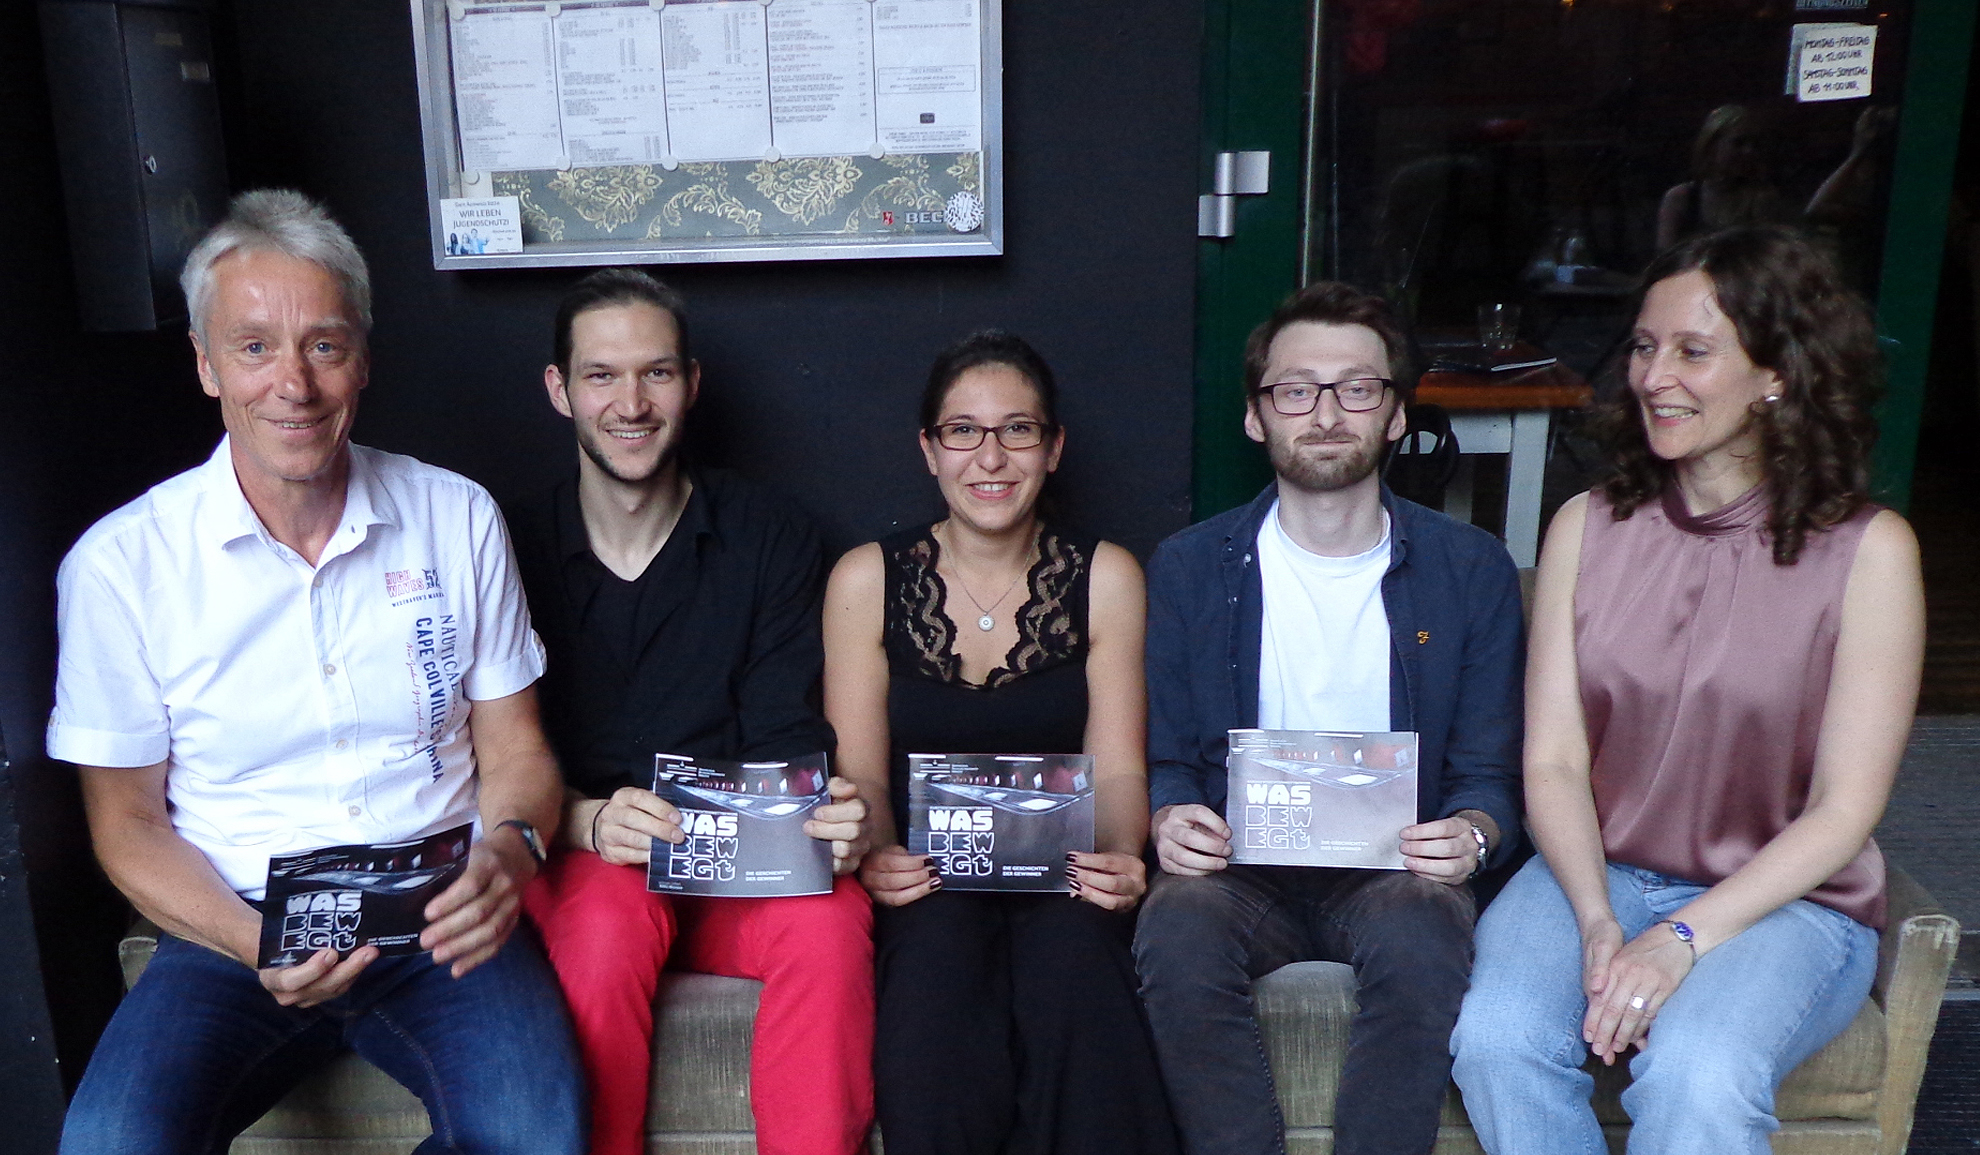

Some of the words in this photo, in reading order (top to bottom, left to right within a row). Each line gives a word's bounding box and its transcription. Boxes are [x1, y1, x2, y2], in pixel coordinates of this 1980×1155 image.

[1811, 53, 1824, 63] AB
[1808, 83, 1821, 93] AB
[459, 210, 475, 218] WIR
[476, 209, 501, 217] LEBEN
[905, 211, 947, 224] BEC
[385, 570, 411, 585] HIGH
[386, 578, 424, 598] WAVES
[416, 617, 434, 657] CAPE
[440, 614, 460, 691] NAUTICAL
[1247, 784, 1311, 805] WAS
[929, 810, 993, 831] WAS
[1245, 805, 1312, 827] BEW
[928, 832, 994, 854] BEW
[286, 892, 363, 914] WAS
